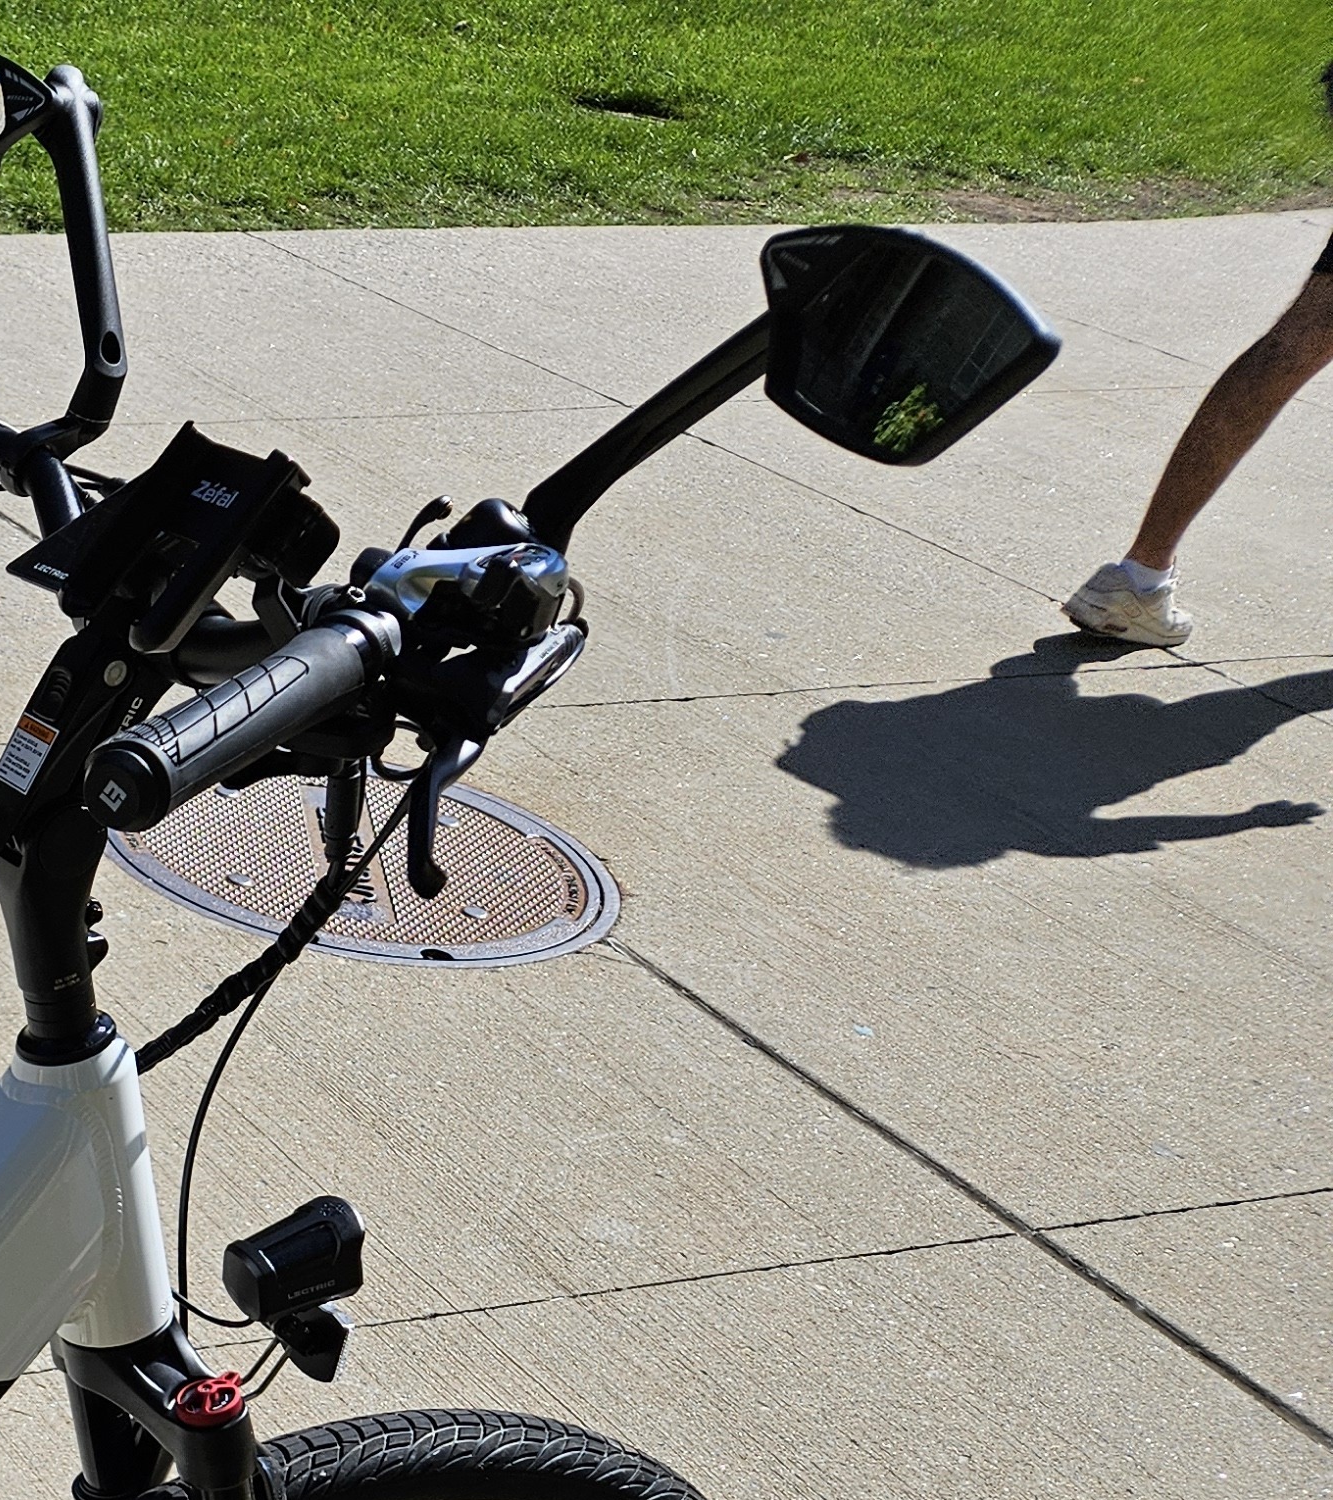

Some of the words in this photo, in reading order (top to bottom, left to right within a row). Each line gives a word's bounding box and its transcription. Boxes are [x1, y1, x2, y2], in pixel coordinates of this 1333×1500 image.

[190, 479, 240, 509] Zéfal
[33, 562, 69, 580] LECTRIC
[287, 1279, 336, 1300] LECTRIC
